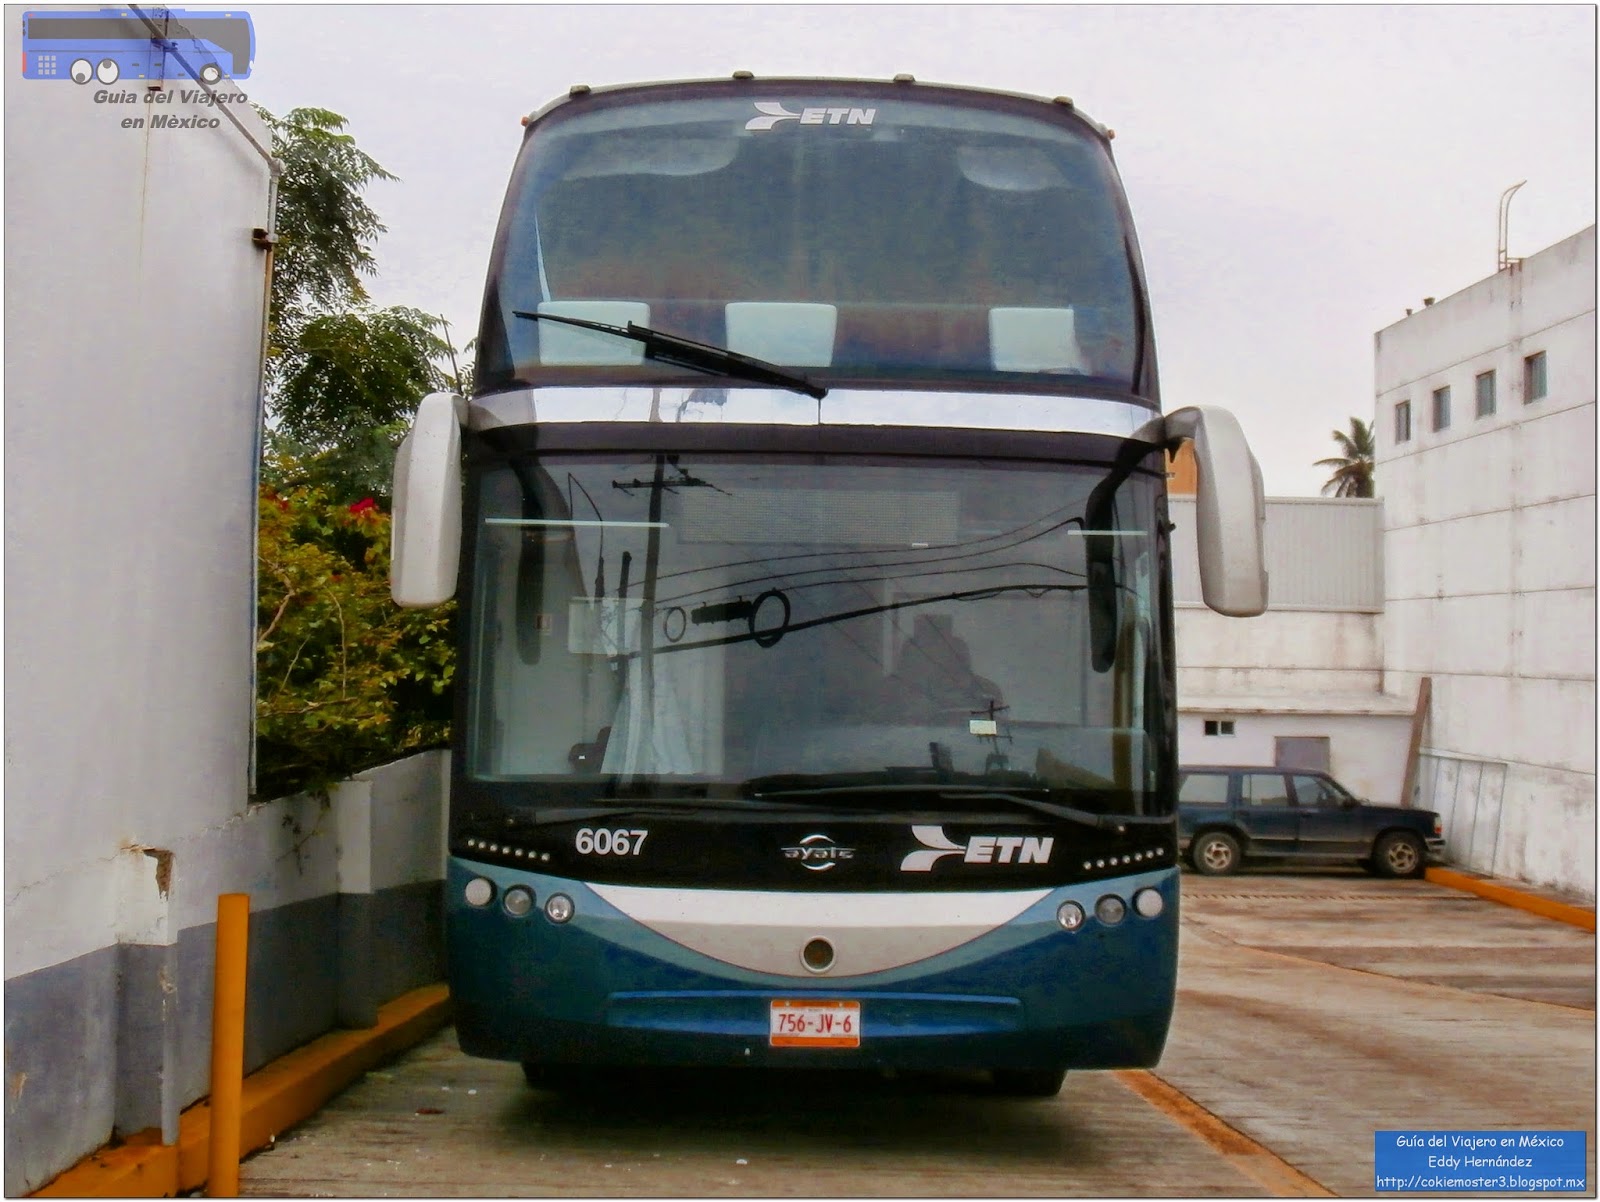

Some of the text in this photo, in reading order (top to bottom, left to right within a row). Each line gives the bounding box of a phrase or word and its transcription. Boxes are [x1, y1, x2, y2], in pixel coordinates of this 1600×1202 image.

[800, 107, 876, 124] ETN
[575, 828, 648, 856] 6067
[964, 836, 1054, 863] ETN
[779, 1013, 851, 1033] 756-JV-6
